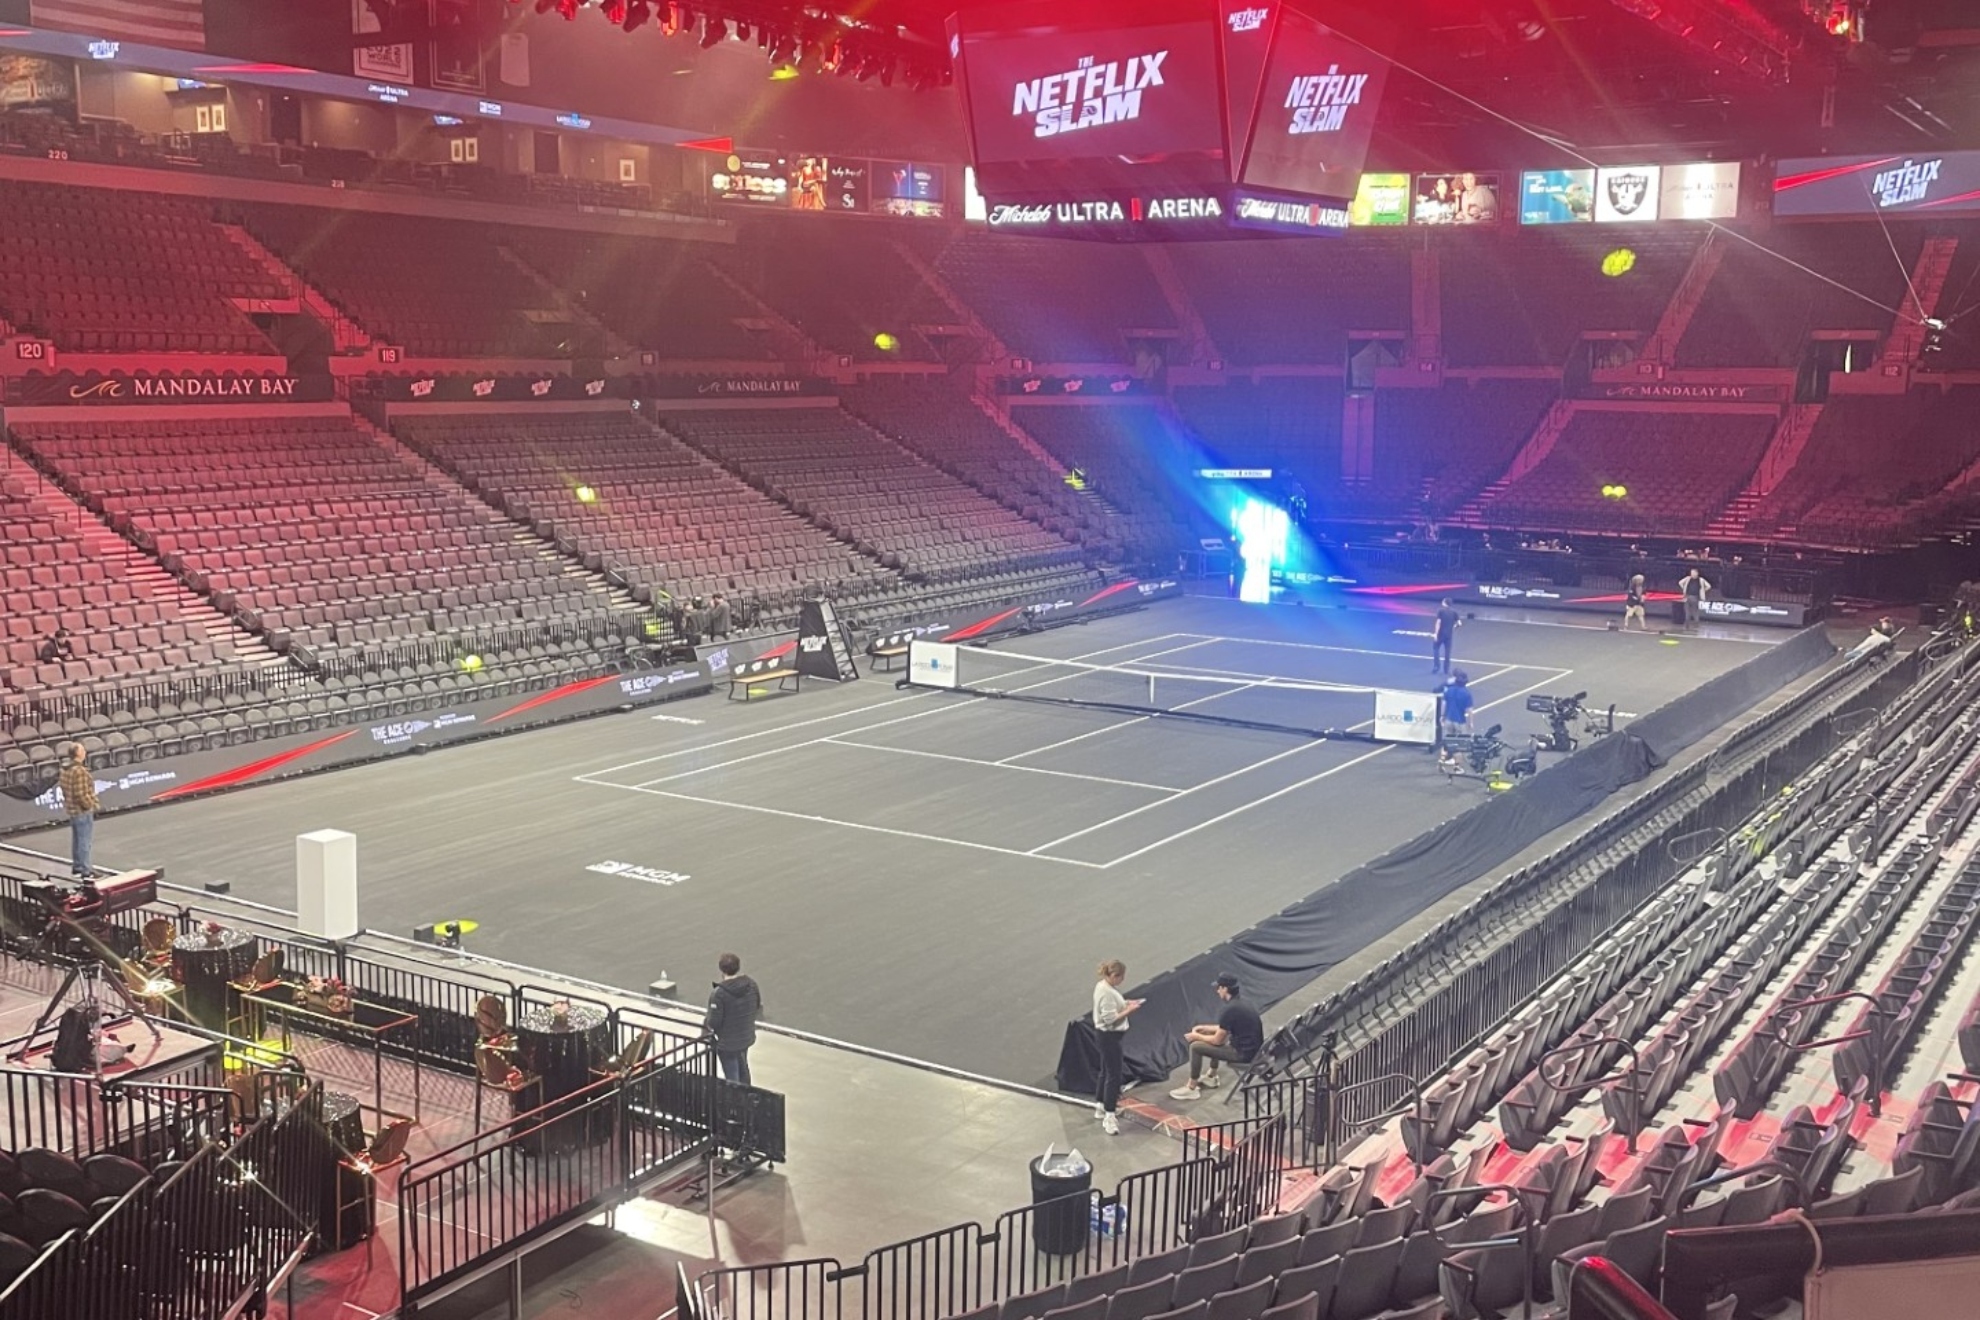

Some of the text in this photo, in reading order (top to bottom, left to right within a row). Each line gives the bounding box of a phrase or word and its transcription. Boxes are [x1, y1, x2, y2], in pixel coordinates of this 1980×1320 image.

[1228, 8, 1268, 24] NETFLIX
[1078, 55, 1094, 68] THE
[1012, 50, 1168, 116] NETFLIX
[1284, 73, 1369, 108] NETFLIX
[1034, 89, 1142, 138] SLAM
[1288, 104, 1348, 134] SLAM
[48, 149, 68, 160] 220
[1872, 159, 1942, 194] NETFLIX
[1880, 181, 1928, 207] SLAM
[988, 197, 1222, 225] Michelob ULTRA ARENA
[1276, 201, 1311, 225] ULTRA
[19, 343, 42, 358] 120
[382, 350, 396, 362] 119
[134, 378, 296, 396] MANDALAY BAY
[726, 381, 801, 392] MANDALAY BAY
[1641, 386, 1746, 397] MANDALAY BAY
[620, 680, 633, 692] THE
[633, 677, 646, 691] ACE
[371, 726, 388, 740] THE
[388, 722, 404, 737] ACE
[626, 866, 691, 882] MGM
